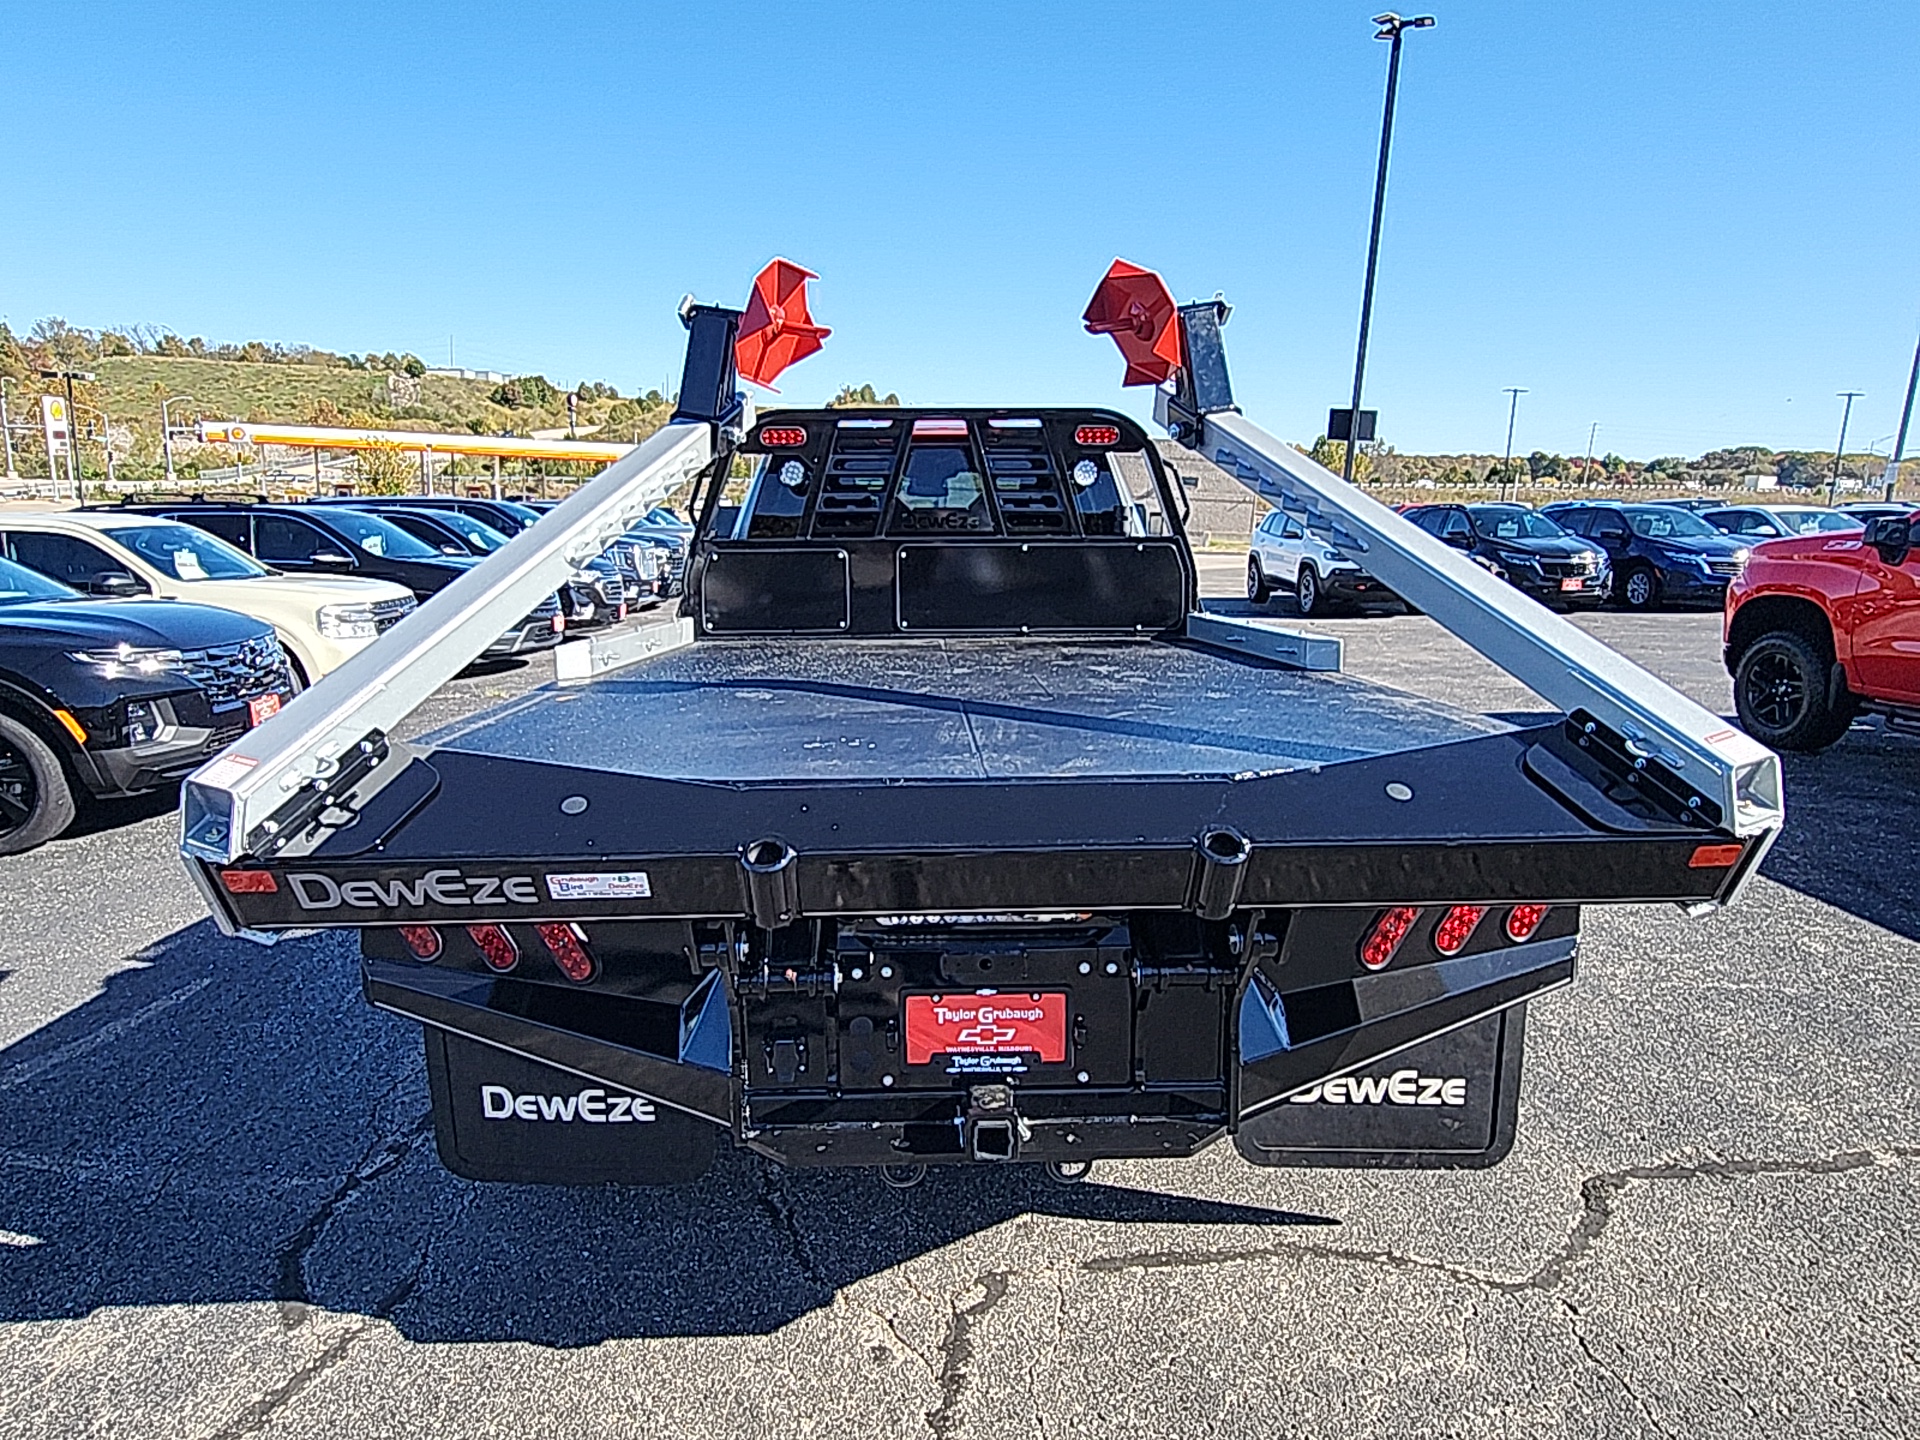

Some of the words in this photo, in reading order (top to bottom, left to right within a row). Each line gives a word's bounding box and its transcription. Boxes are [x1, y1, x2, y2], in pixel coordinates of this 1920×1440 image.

[934, 1007, 976, 1024] Taylor
[978, 1007, 1043, 1023] Grubaugh
[952, 1056, 979, 1067] Taylor
[482, 1085, 656, 1122] DewEze
